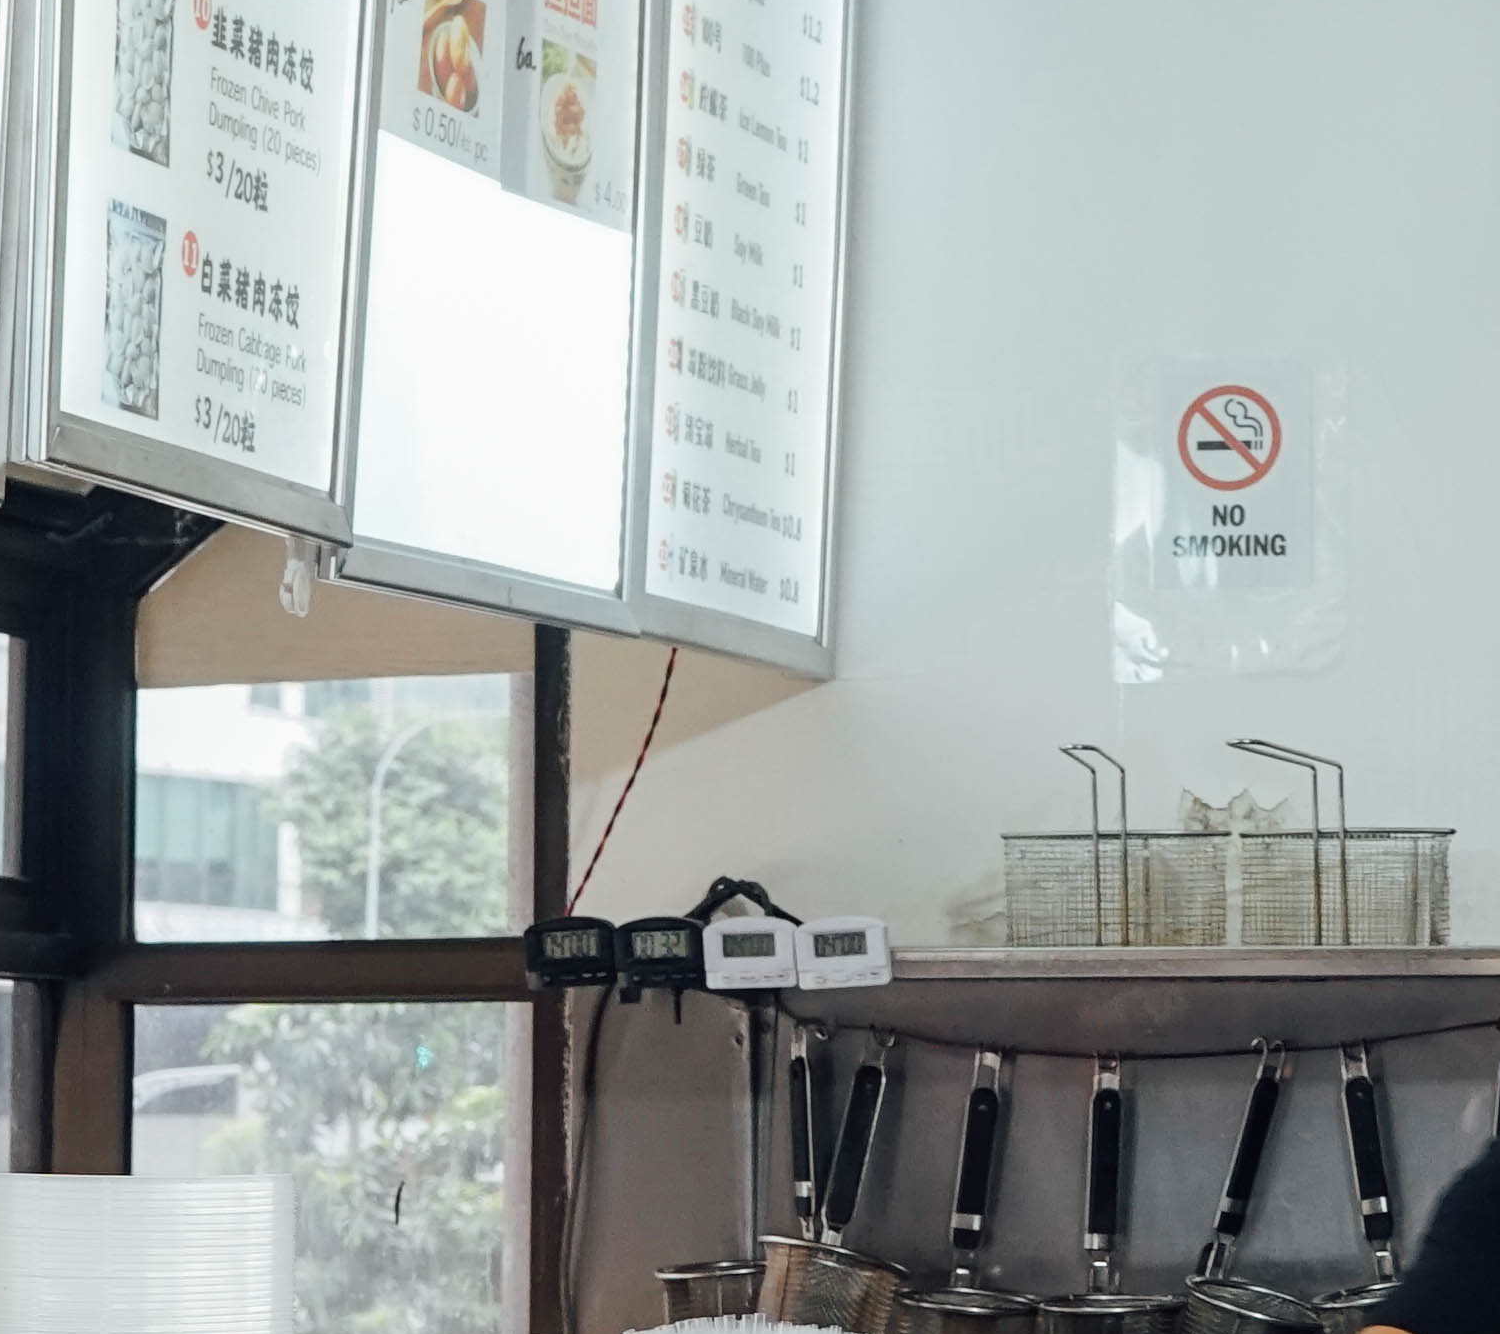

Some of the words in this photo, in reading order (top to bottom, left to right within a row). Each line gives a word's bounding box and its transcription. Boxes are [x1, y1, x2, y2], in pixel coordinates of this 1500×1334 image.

[209, 65, 248, 106] Frozen
[250, 84, 281, 121] Chive
[282, 99, 306, 132] Pork
[208, 100, 258, 152] Dumpling
[197, 311, 235, 348] Frozen
[195, 346, 246, 392] Dumpling
[1212, 505, 1245, 527] NO
[1172, 534, 1286, 556] SMOKING
